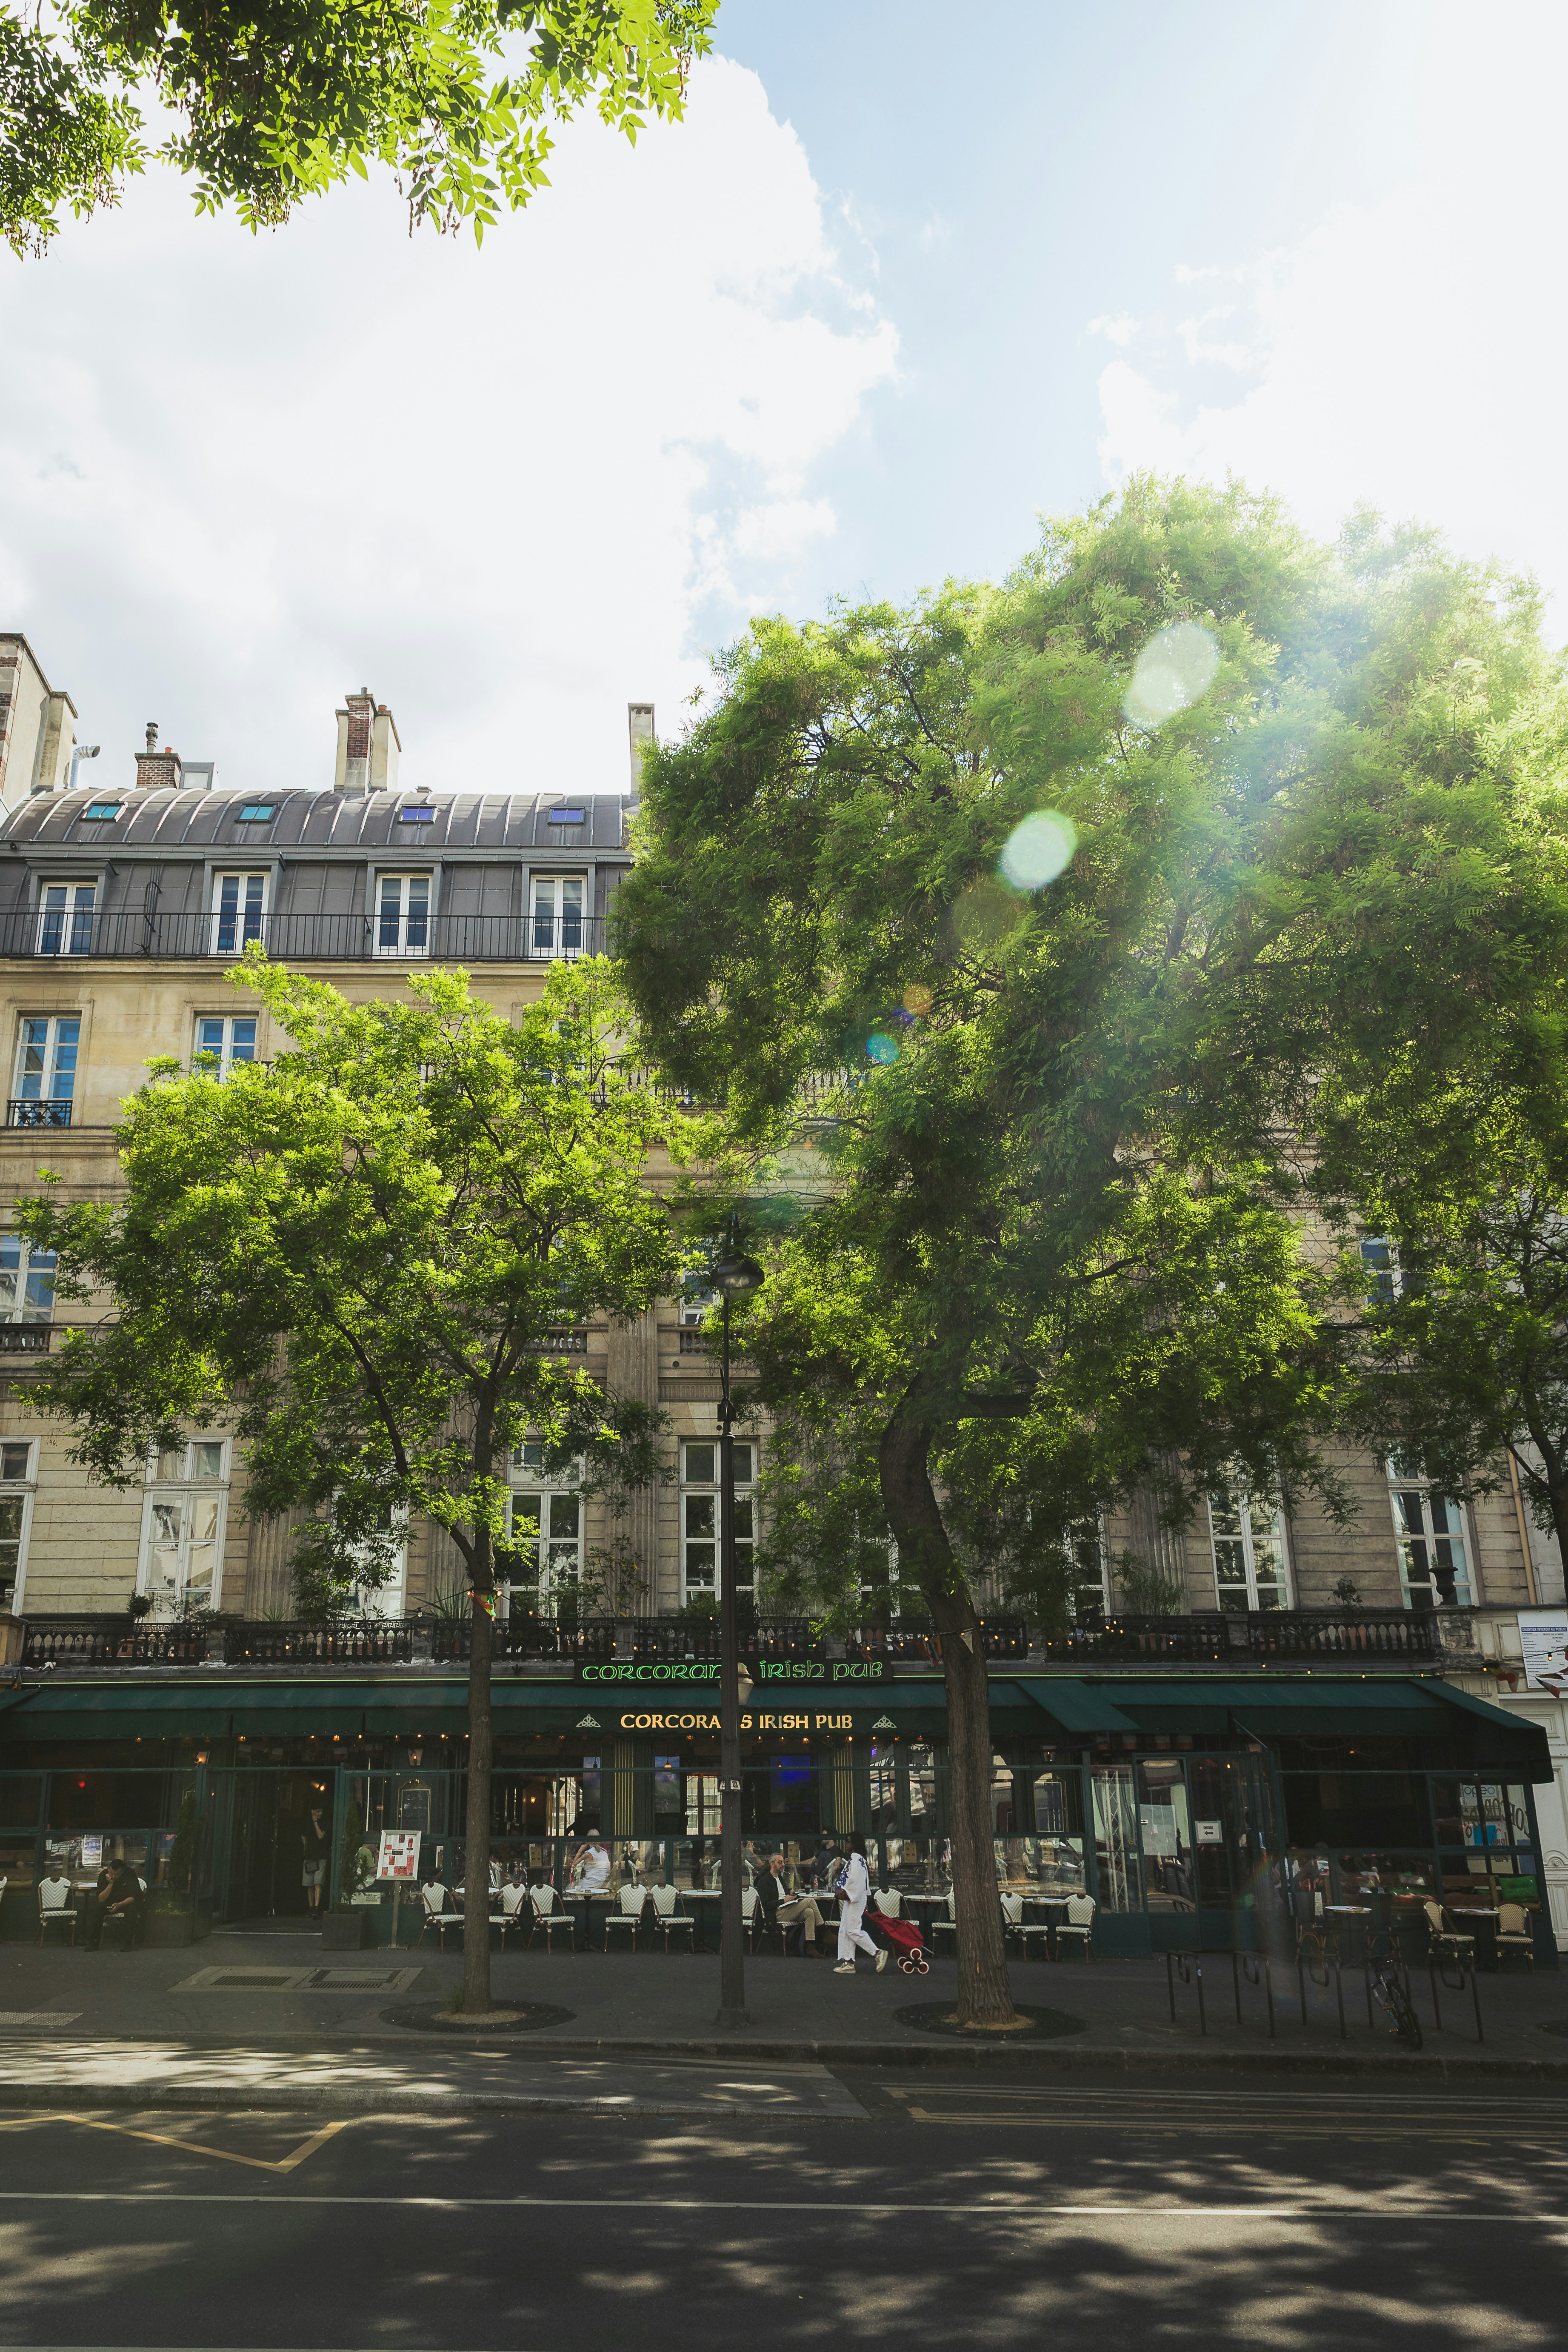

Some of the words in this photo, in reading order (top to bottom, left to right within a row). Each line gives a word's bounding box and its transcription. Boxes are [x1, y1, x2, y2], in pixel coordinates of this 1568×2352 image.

[621, 1714, 752, 1729] CORCORAS
[760, 1715, 808, 1729] IRISH
[816, 1715, 852, 1729] PUB
